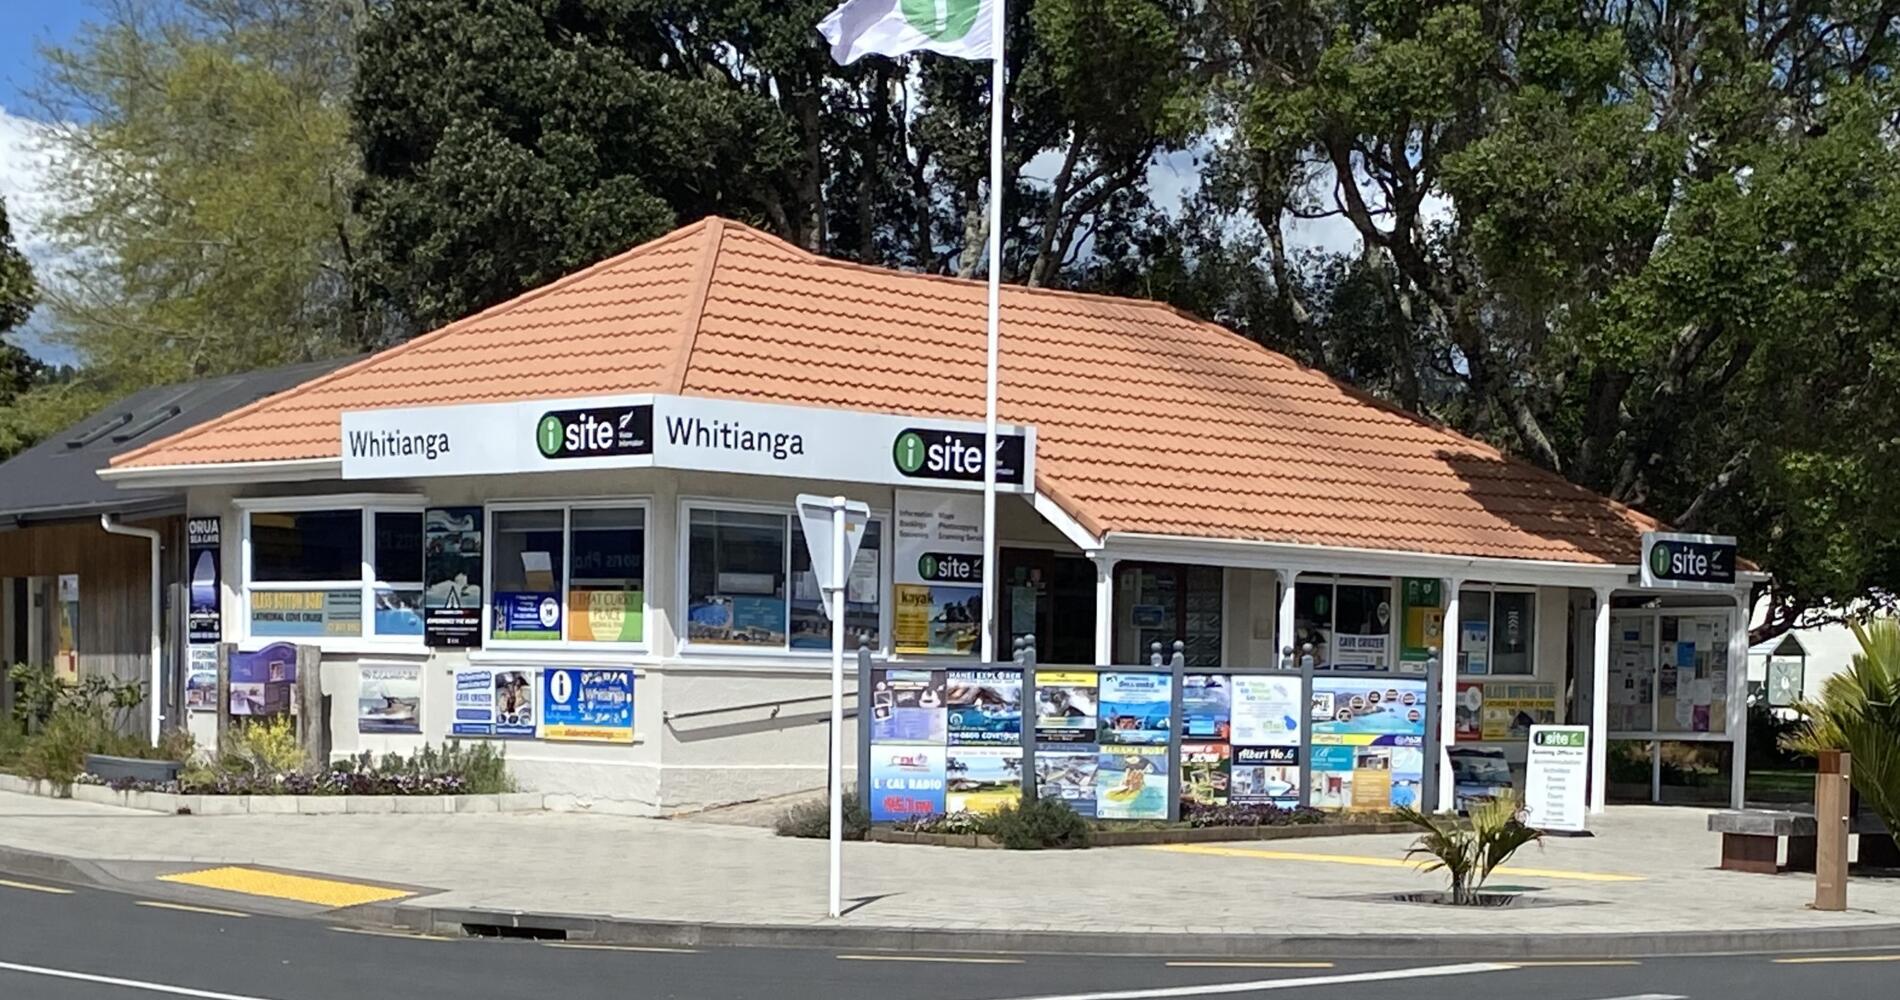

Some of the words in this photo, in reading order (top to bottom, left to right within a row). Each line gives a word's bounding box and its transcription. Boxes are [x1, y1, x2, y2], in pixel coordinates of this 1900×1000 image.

[565, 413, 614, 450] site
[665, 415, 804, 460] Whitianga
[349, 429, 450, 460] Whitianga
[927, 435, 983, 473] site
[189, 520, 219, 534] ORUA
[938, 555, 970, 578] site
[1672, 546, 1708, 576] site
[901, 591, 934, 607] kayak
[1545, 731, 1569, 745] site
[1238, 748, 1269, 760] Albert
[909, 778, 942, 790] RADIO
